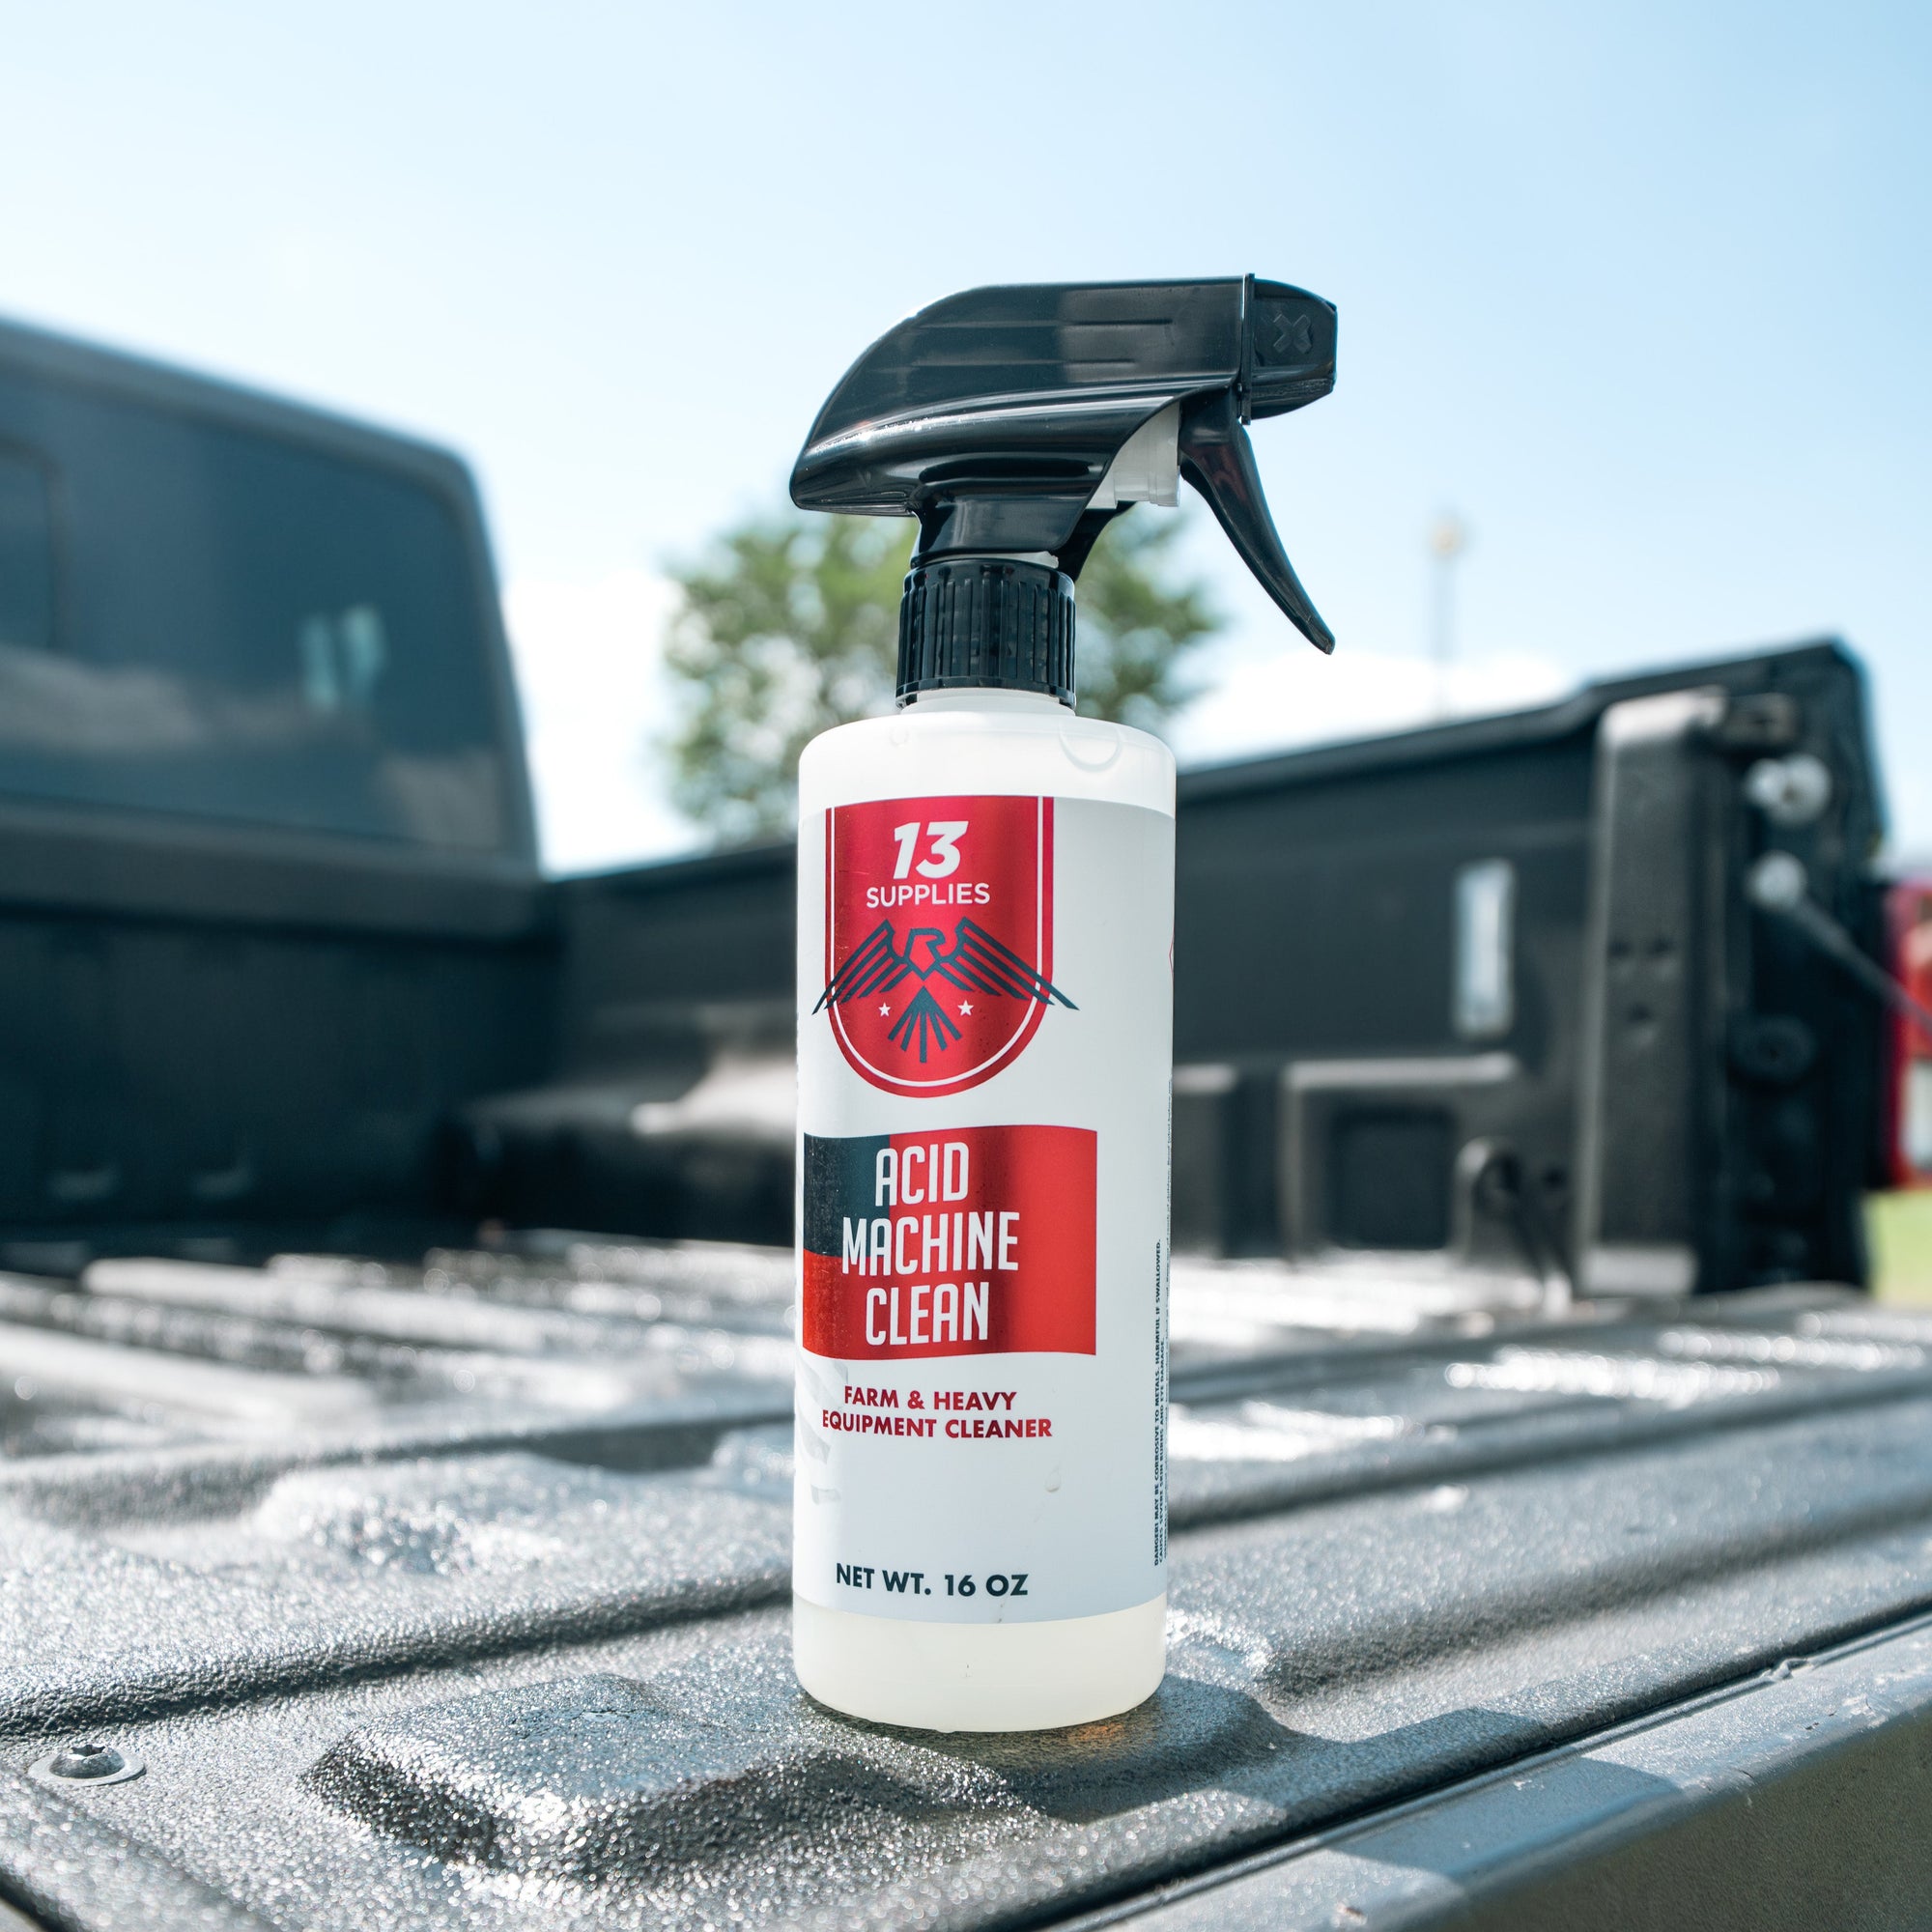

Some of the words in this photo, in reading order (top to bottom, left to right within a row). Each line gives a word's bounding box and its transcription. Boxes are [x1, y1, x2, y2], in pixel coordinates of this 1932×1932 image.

[893, 820, 969, 880] 13
[866, 882, 991, 909] SUPPLIES
[874, 1142, 970, 1208] ACID
[841, 1211, 1020, 1276] MACHINE
[866, 1281, 990, 1347] CLEAN
[843, 1385, 899, 1409] FARM
[907, 1390, 925, 1410] &
[933, 1391, 1018, 1411] HEAVY
[822, 1408, 937, 1438] EQUIPMENT
[945, 1418, 1053, 1439] CLEANER
[836, 1562, 876, 1589] NET
[882, 1570, 931, 1596] WT.
[944, 1575, 978, 1597] 16
[984, 1574, 1029, 1597] OZ
